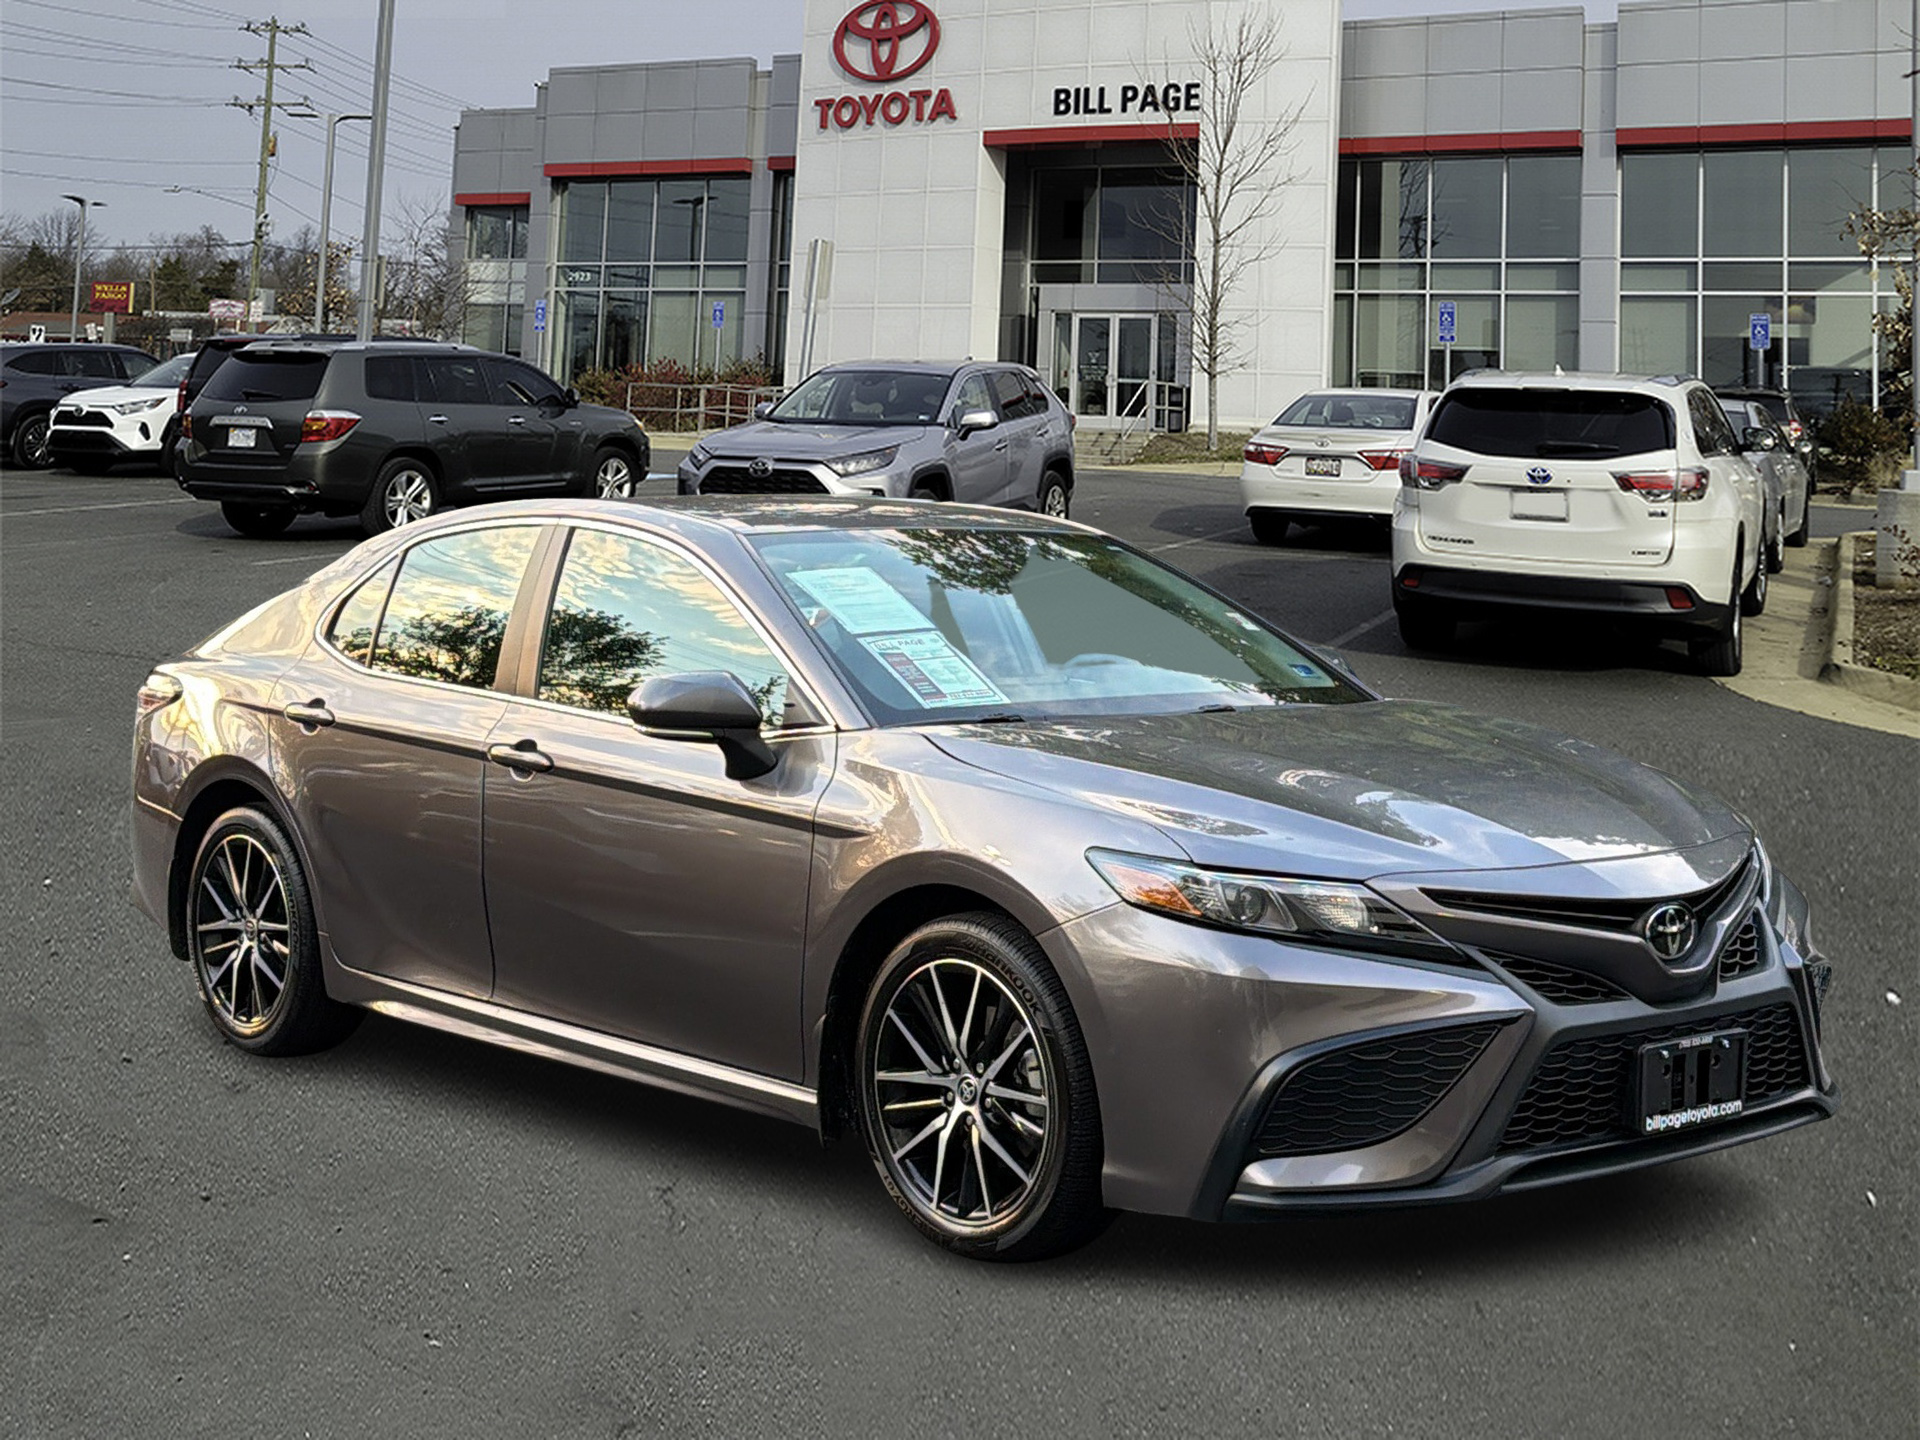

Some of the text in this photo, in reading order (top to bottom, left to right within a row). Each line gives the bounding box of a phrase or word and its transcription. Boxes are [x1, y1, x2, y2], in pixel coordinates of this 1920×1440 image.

[814, 87, 957, 130] TOYOTA
[1053, 82, 1201, 116] BILL PAGE
[1645, 1100, 1742, 1131] billpagetoyota.com
